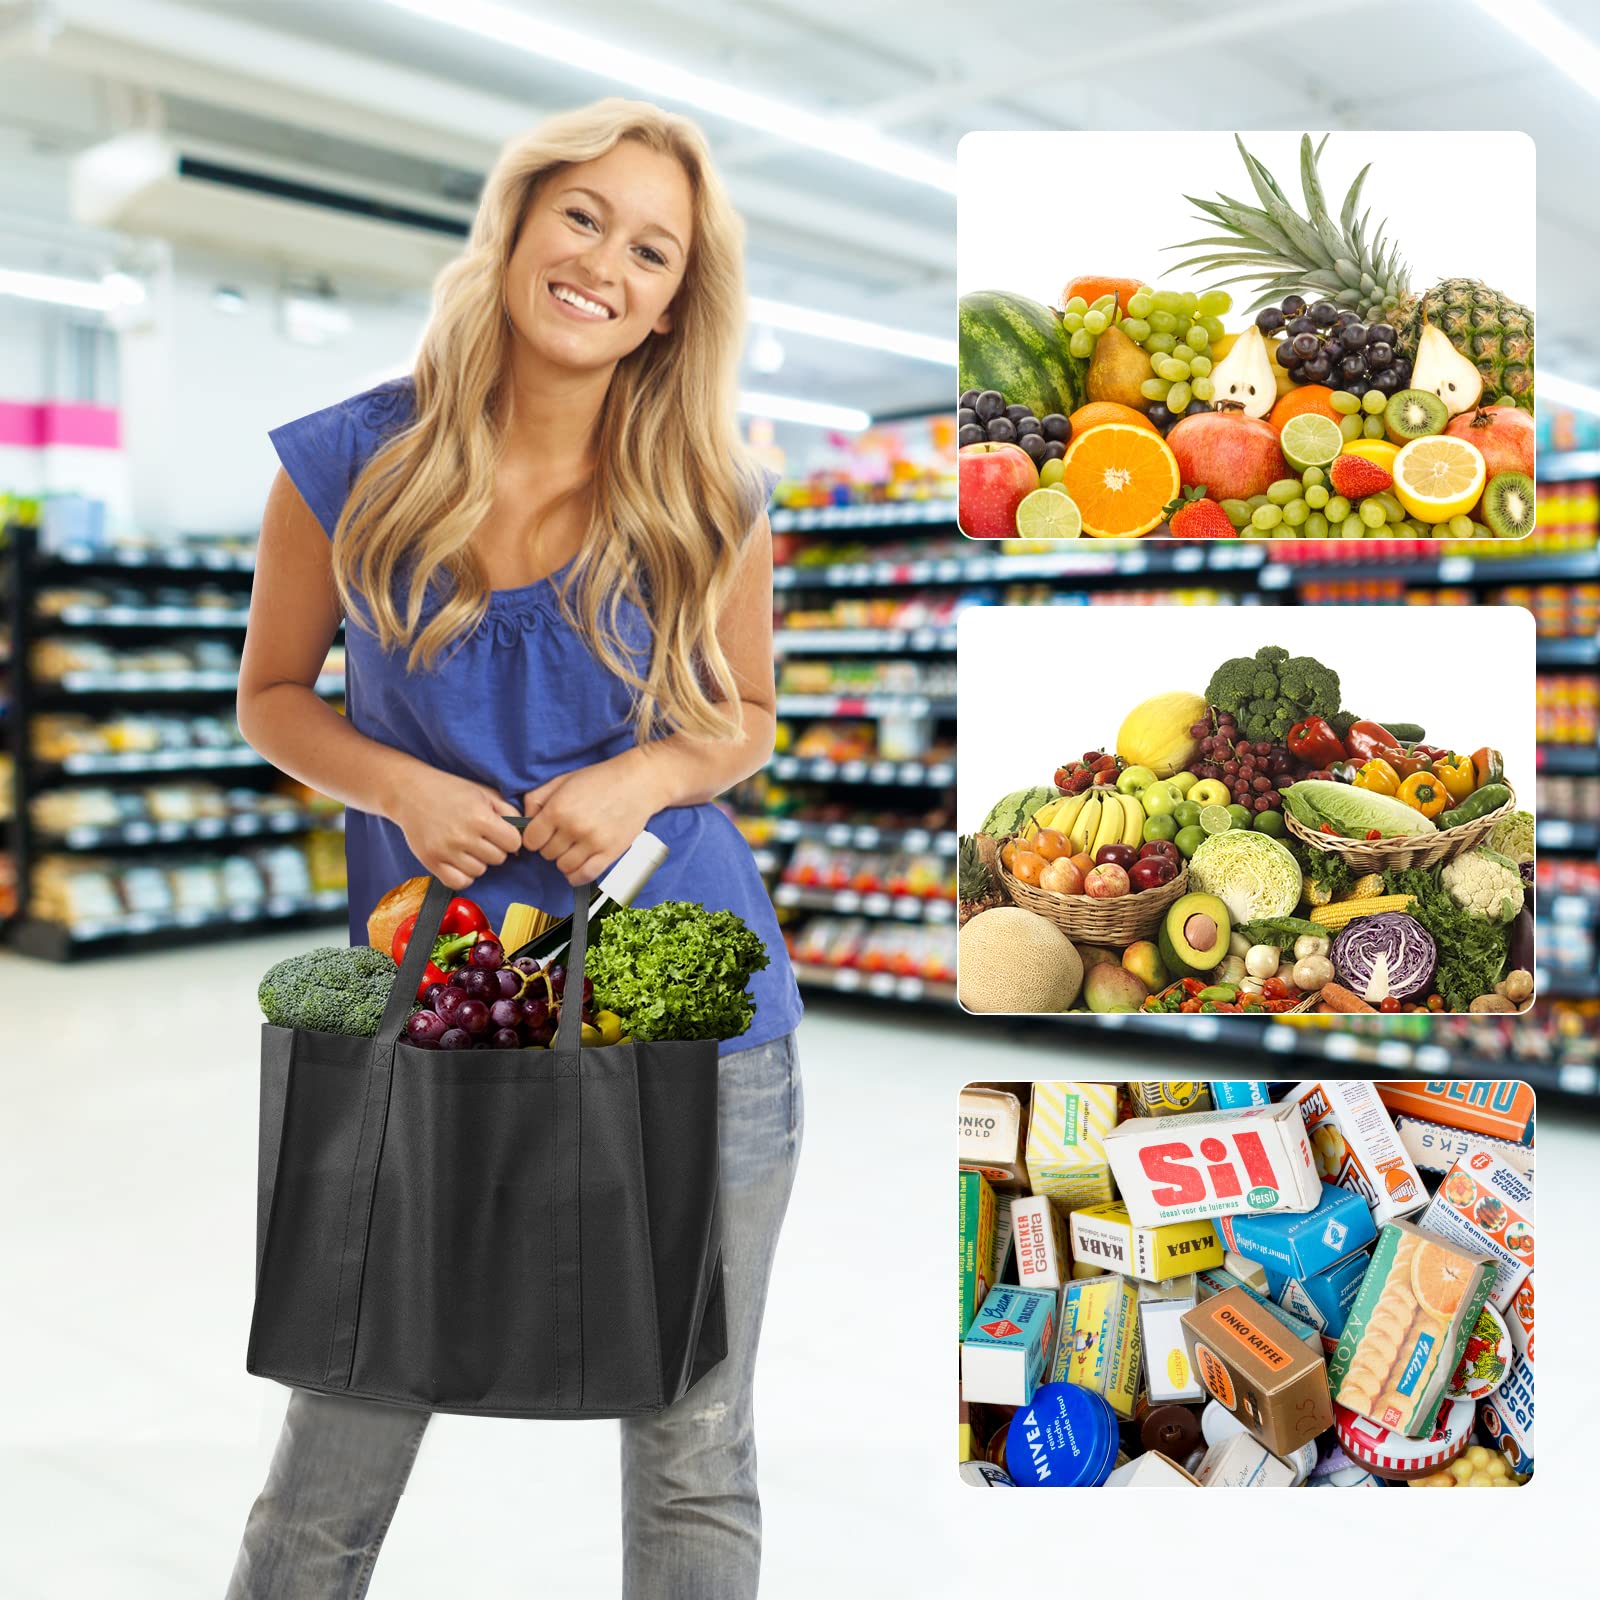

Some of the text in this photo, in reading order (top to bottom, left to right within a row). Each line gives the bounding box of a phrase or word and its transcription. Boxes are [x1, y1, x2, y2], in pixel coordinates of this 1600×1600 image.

[1138, 1131, 1279, 1207] Sil
[1501, 1167, 1533, 1196] Leimer
[1249, 1189, 1276, 1205] Persil
[1493, 1170, 1531, 1201] Semmel
[1181, 1204, 1198, 1215] voor
[1199, 1203, 1208, 1213] de
[1017, 1215, 1035, 1275] DR.OETKER
[1033, 1212, 1048, 1273] Galetta
[1079, 1235, 1124, 1261] KABA
[1166, 1235, 1215, 1257] KABA
[1436, 1199, 1462, 1223] Leimer
[1463, 1221, 1521, 1270] Semmelbrösel
[982, 1293, 1014, 1319] Cream
[1017, 1297, 1041, 1324] CRACKERS
[1118, 1294, 1129, 1321] BOTER
[1114, 1319, 1124, 1344] MET
[1220, 1311, 1284, 1366] ONKO KAFFEE
[1326, 1312, 1363, 1390] AZORA
[1109, 1344, 1121, 1392] VOLVET
[1202, 1350, 1219, 1396] ONKO
[1022, 1408, 1051, 1482] NIVEA
[1045, 1424, 1056, 1451] reine,
[1053, 1415, 1065, 1449] frische,
[1063, 1418, 1081, 1458] gesunde
